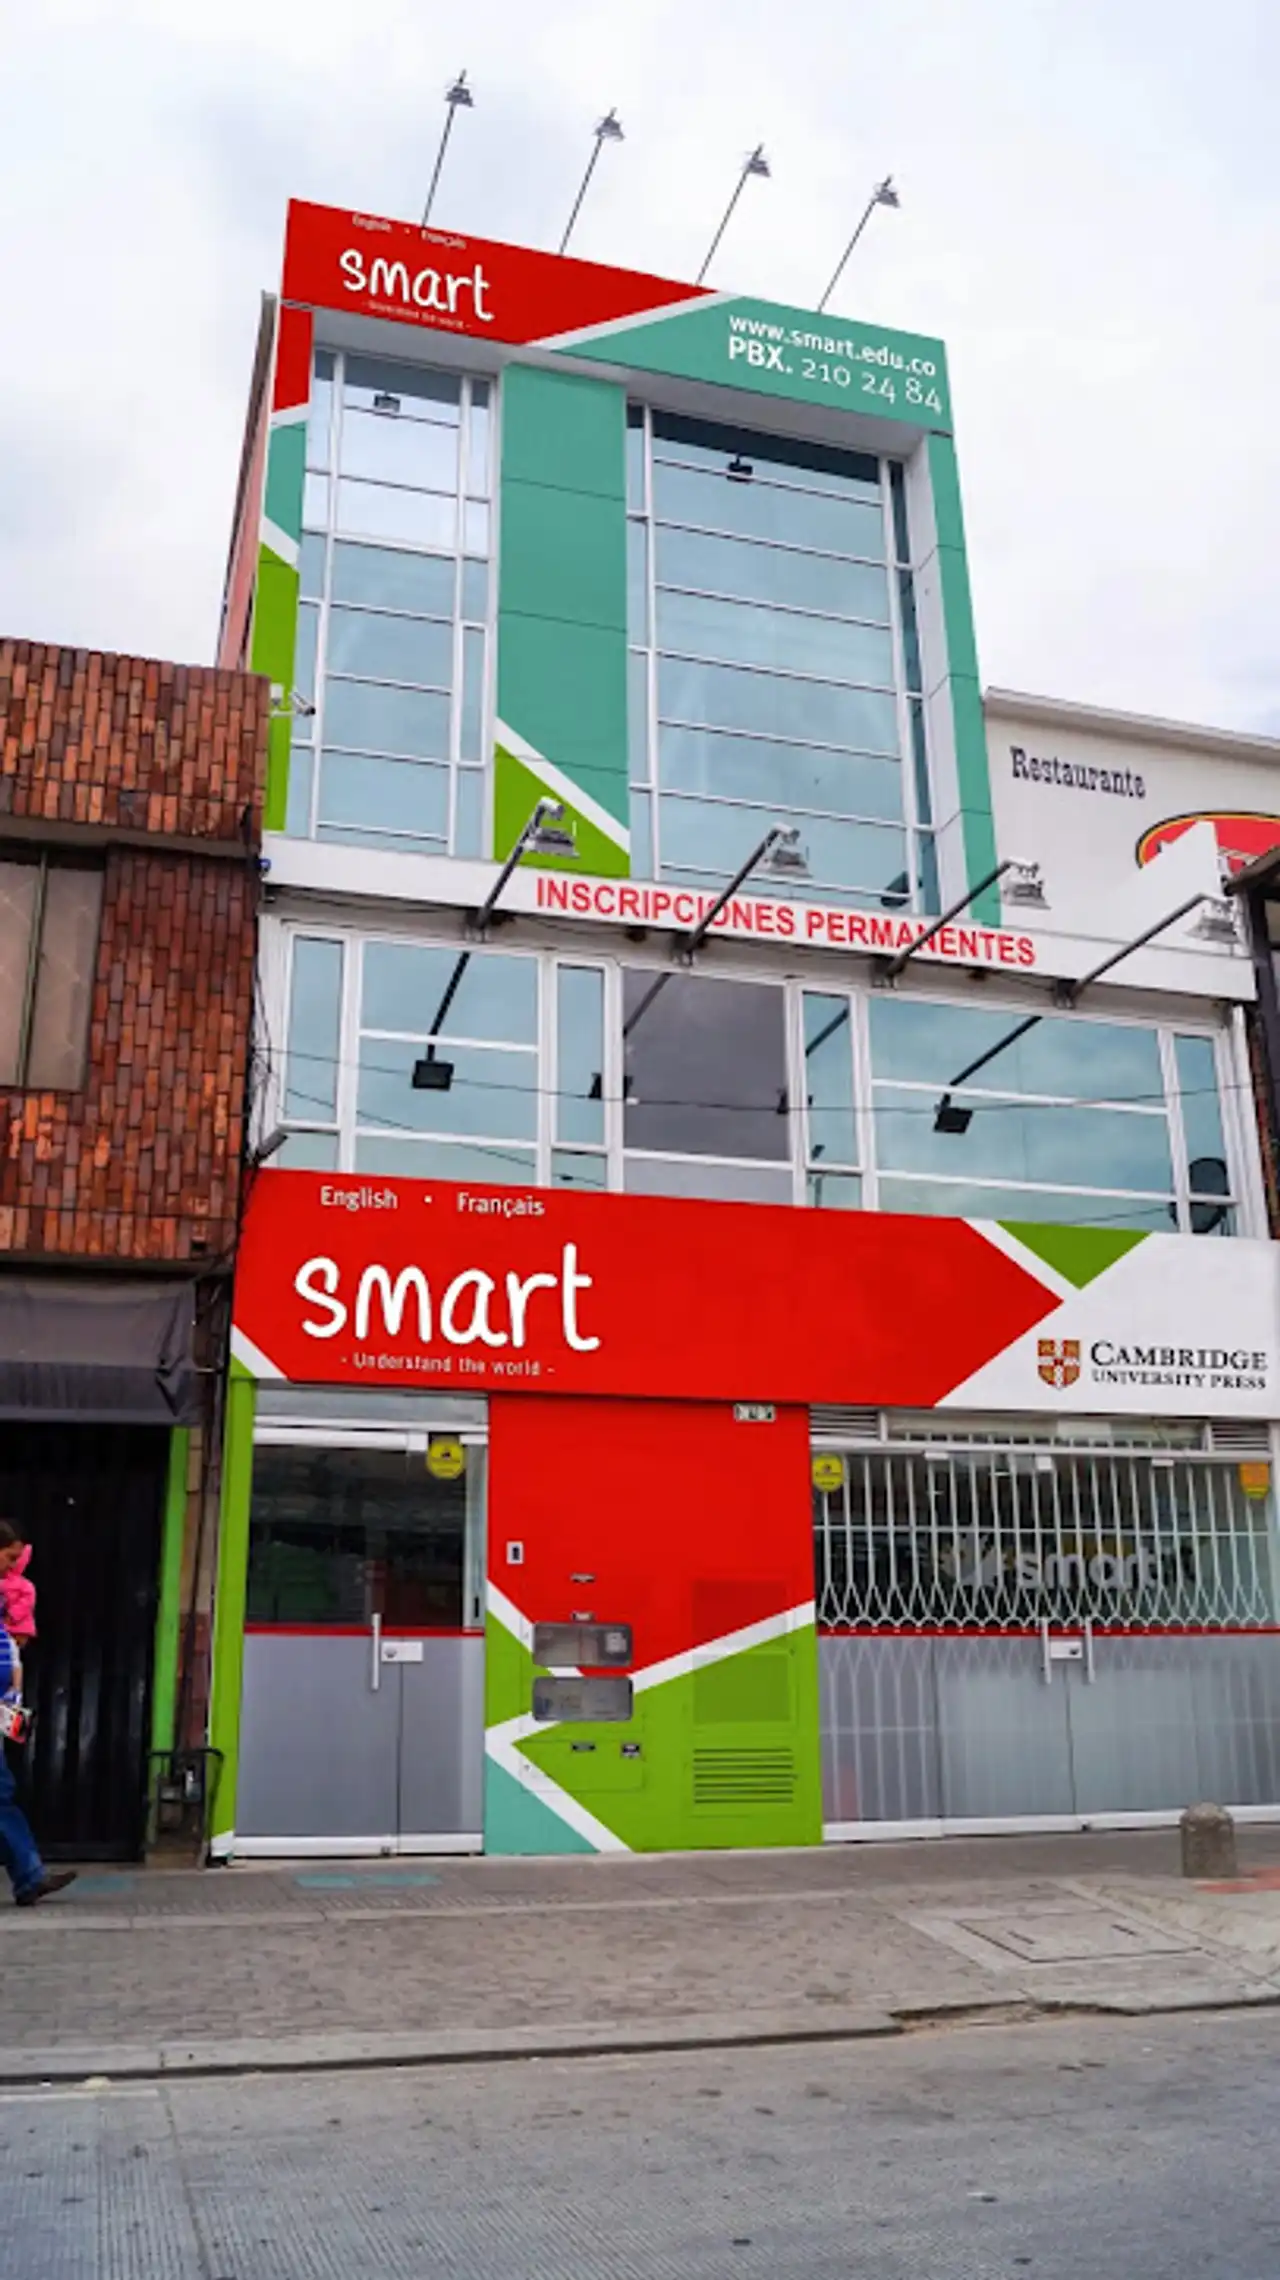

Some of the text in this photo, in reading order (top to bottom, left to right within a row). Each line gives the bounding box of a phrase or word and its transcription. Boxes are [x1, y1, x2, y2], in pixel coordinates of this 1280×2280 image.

[339, 248, 495, 322] smart
[729, 314, 937, 377] www.smart.edu.co
[728, 335, 943, 415] PBX. 210 24 84
[1009, 746, 1147, 800] Restaurante
[536, 876, 796, 937] INSCRIPCIONES
[320, 1185, 547, 1219] English Français
[294, 1242, 601, 1352] smart
[352, 1351, 541, 1377] Understand the world
[1090, 1339, 1268, 1373] CAMBRIDGE
[1091, 1368, 1267, 1391] UNIVERSITY PRESS
[1014, 1547, 1160, 1590] smart
